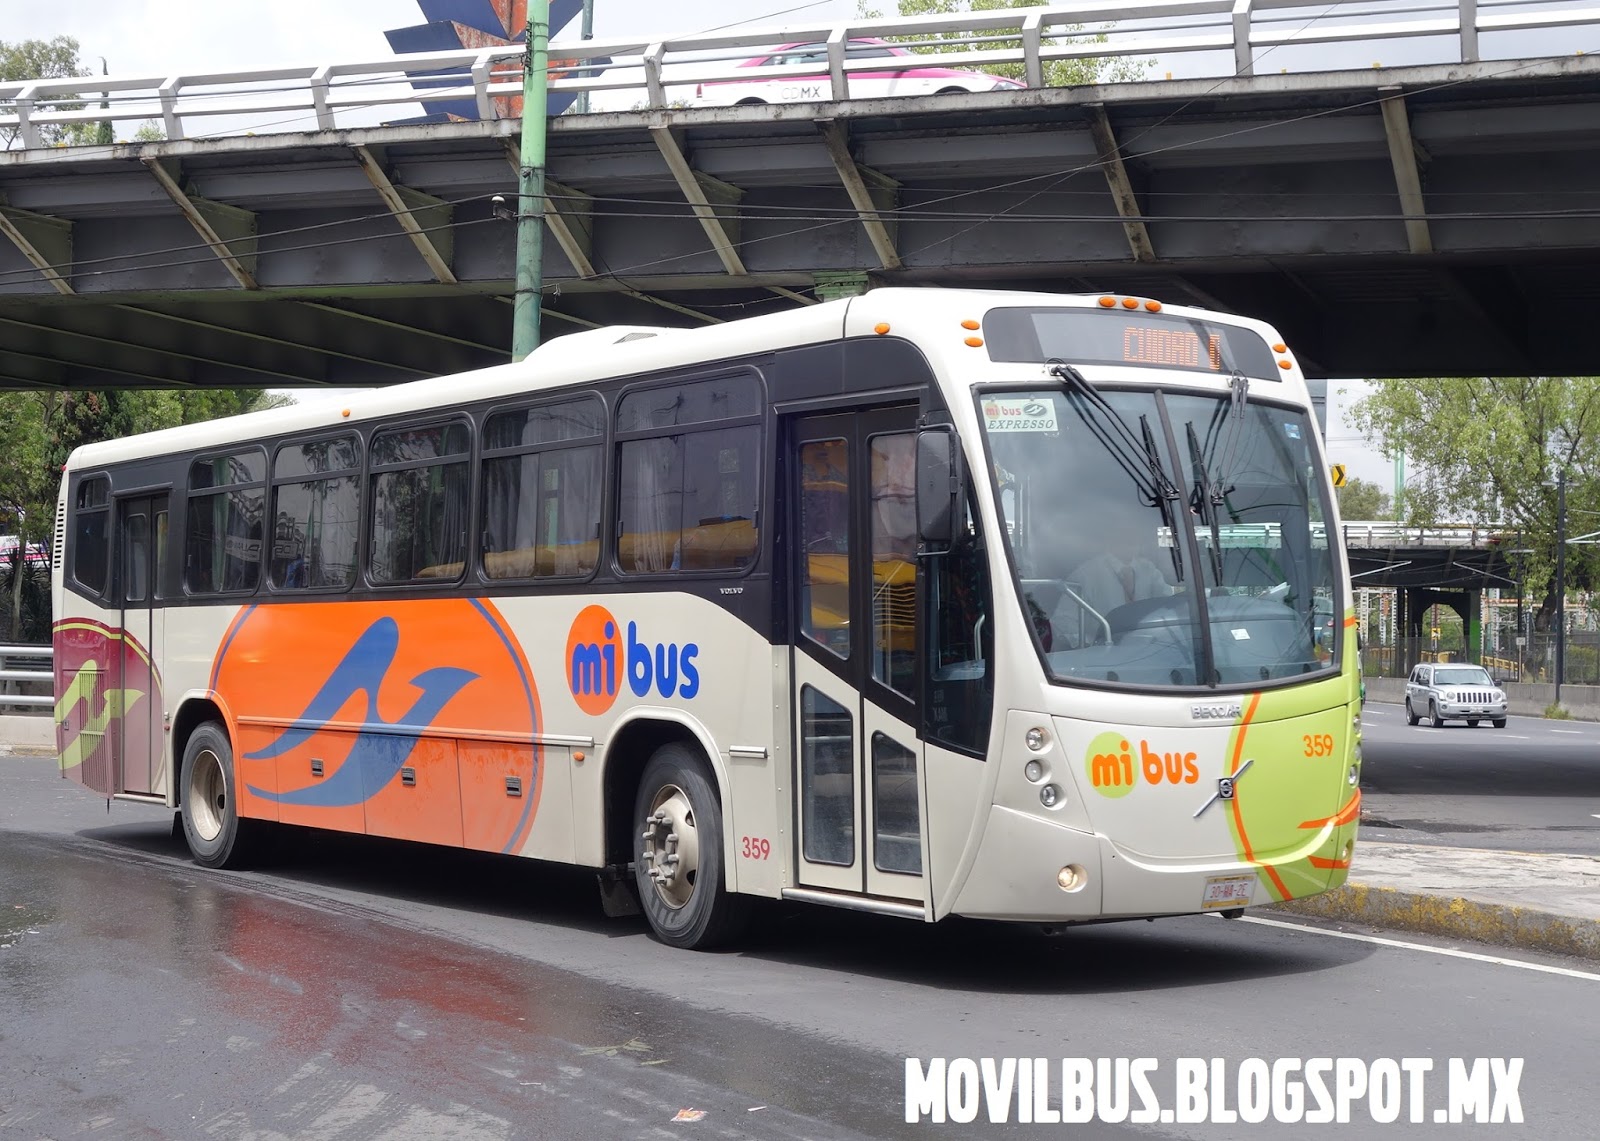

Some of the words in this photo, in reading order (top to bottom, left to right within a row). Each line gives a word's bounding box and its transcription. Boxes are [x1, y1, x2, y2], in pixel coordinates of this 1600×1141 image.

[781, 86, 821, 100] CDMX
[985, 404, 999, 416] mi
[1001, 406, 1022, 416] bus
[987, 419, 1054, 430] EXPRESSO
[572, 620, 615, 696] mi
[627, 620, 700, 700] bus
[1191, 704, 1243, 720] BECCAR
[1303, 734, 1333, 758] 359
[1092, 739, 1133, 787] mi
[1140, 739, 1199, 785] bus
[742, 836, 770, 861] 359
